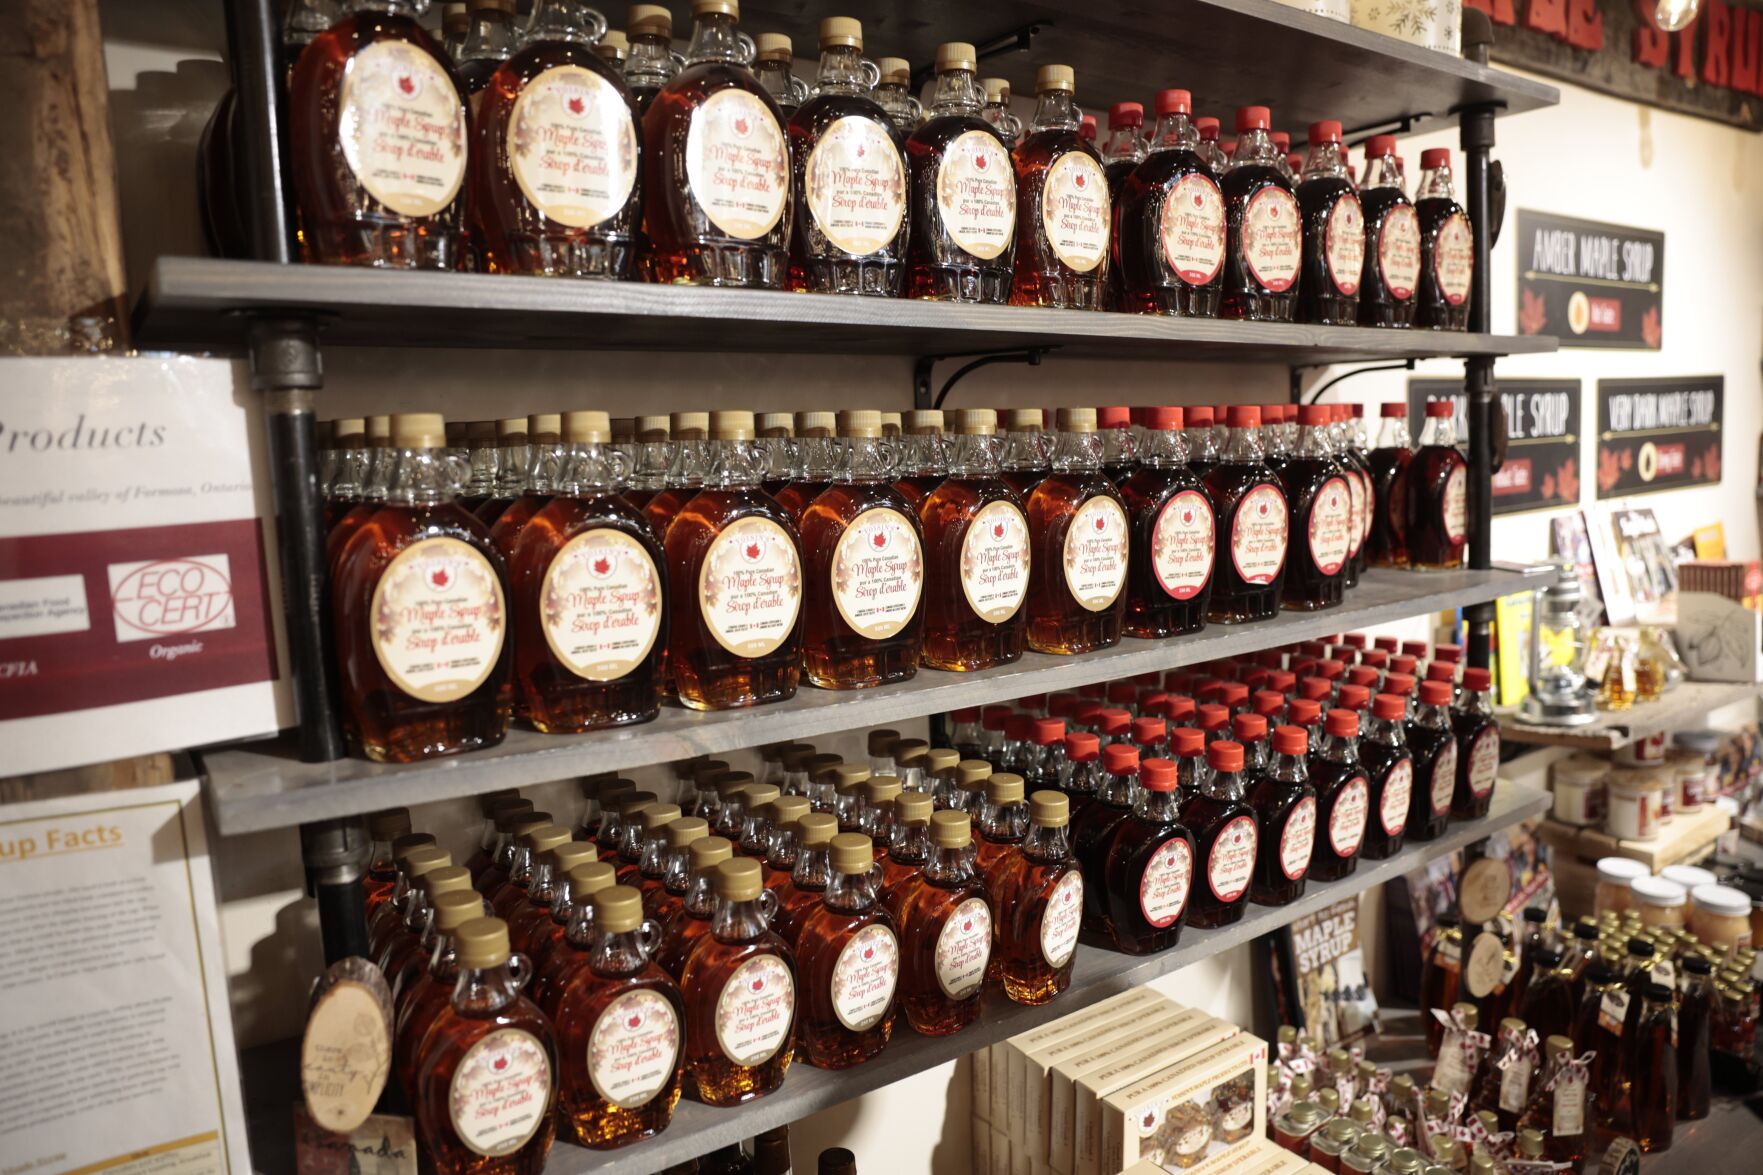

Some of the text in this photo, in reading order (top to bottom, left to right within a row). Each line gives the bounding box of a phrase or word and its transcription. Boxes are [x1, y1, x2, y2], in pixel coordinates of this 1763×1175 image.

[1639, 0, 1763, 96] SYRU
[0, 413, 167, 452] roducts
[977, 550, 1019, 565] Maple Syrup
[852, 562, 907, 578] Maple Syrup
[137, 566, 205, 600] ECO
[722, 574, 784, 591] Maple Syrup
[856, 587, 877, 600] Sirop
[139, 592, 220, 627] CERT
[568, 591, 639, 608] Maple Syrup
[726, 601, 750, 616] Sirop
[150, 639, 204, 661] Organic
[46, 824, 123, 851] Facts
[1294, 911, 1356, 955] MAPLE
[1299, 932, 1353, 973] SYRUP
